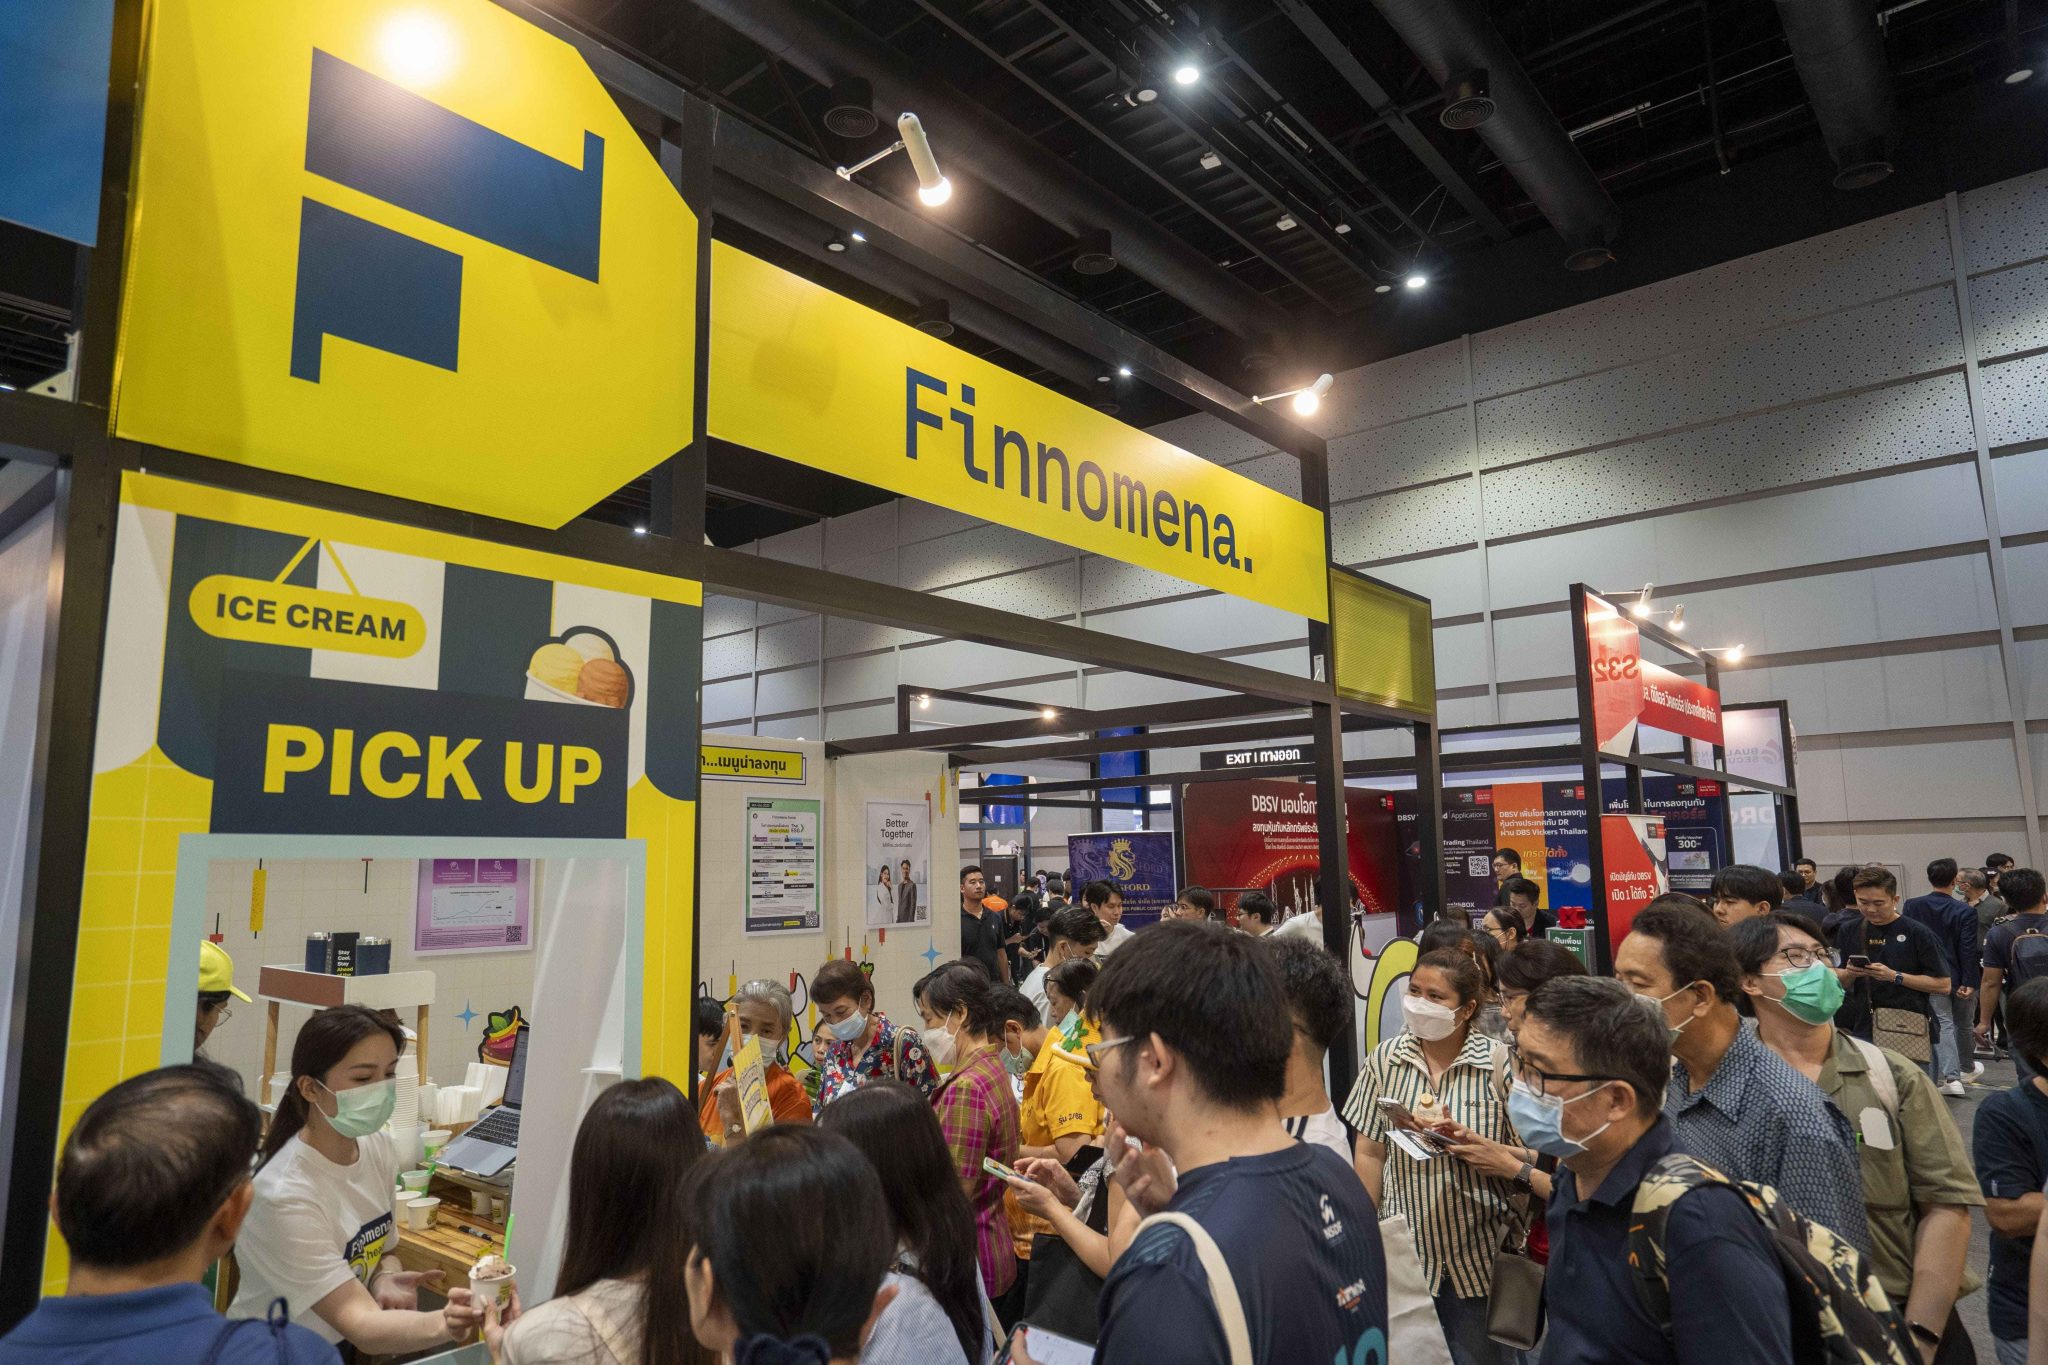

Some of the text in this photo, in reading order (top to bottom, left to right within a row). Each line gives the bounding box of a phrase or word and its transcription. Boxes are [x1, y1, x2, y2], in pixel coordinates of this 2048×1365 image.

[905, 366, 1253, 574] Finnomena.
[216, 593, 406, 642] ICE CREAM
[264, 723, 602, 804] PICK UP
[1226, 752, 1252, 765] EXIT
[1260, 749, 1300, 762] ทางออก
[1252, 795, 1279, 813] DBSV
[885, 818, 909, 828] Better
[1451, 812, 1488, 820] Applications
[880, 829, 914, 840] Together
[1678, 840, 1697, 849] 300
[1637, 872, 1651, 881] DBSV
[1611, 889, 1625, 901] เปิด
[1626, 890, 1630, 900] 1
[1648, 885, 1655, 899] 3
